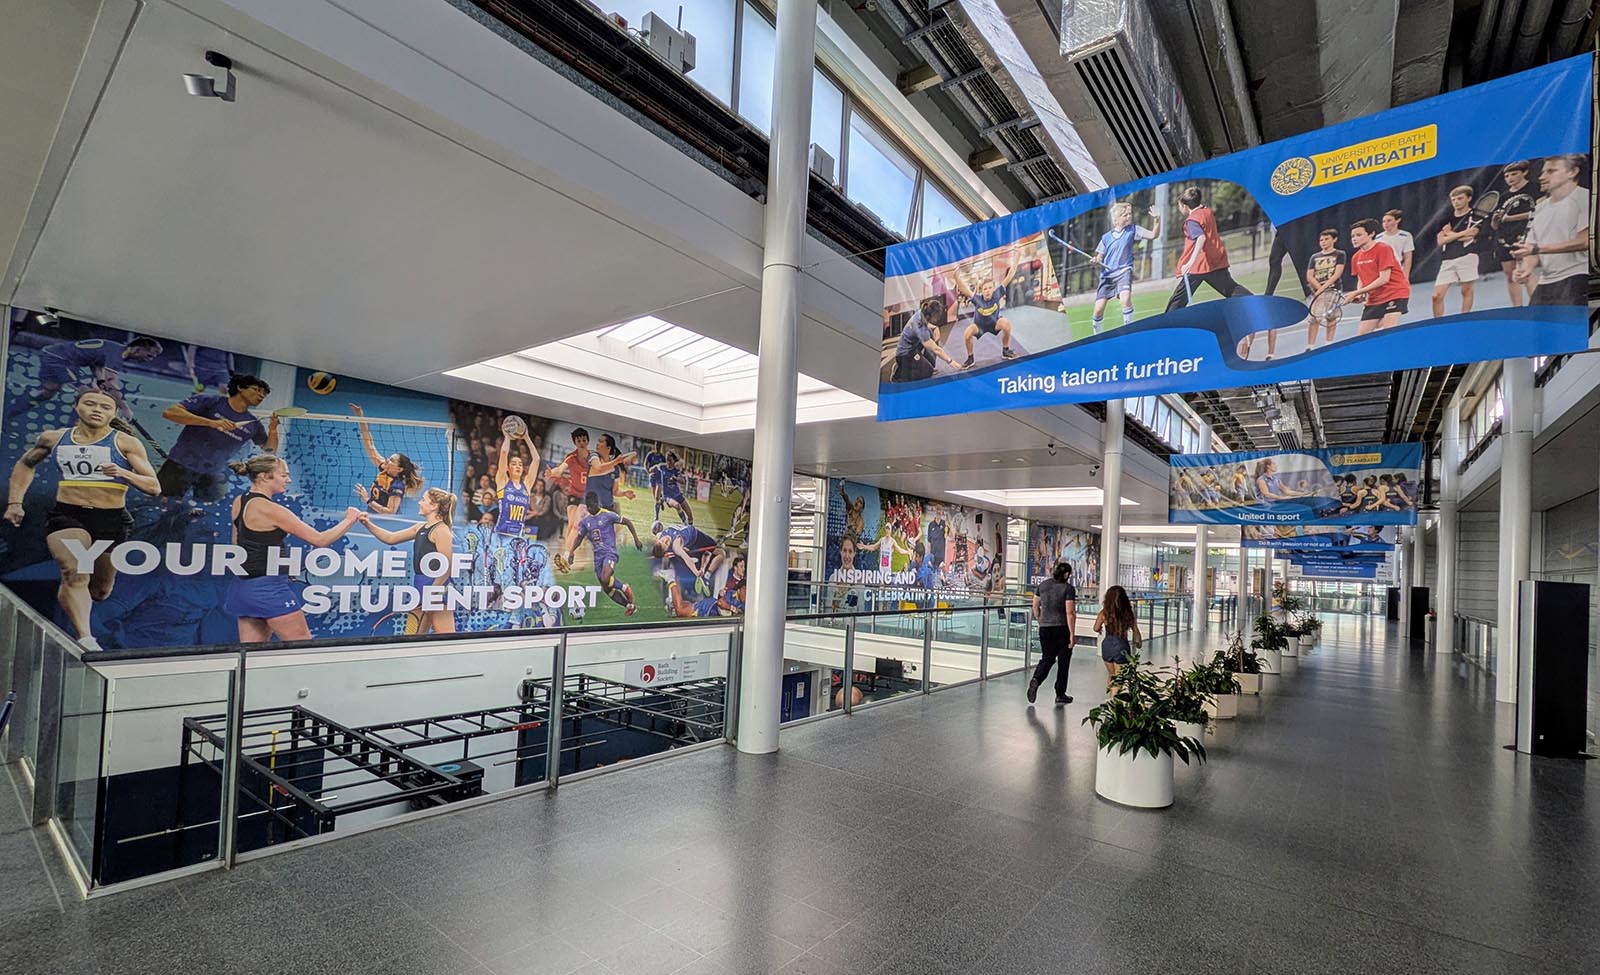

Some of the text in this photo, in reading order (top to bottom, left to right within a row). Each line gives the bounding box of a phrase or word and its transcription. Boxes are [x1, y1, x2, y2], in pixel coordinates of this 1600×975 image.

[1321, 132, 1426, 166] UNIVERSITY OF BATH
[1321, 143, 1426, 179] TEAMBATH
[998, 355, 1203, 394] Taking talent further
[510, 504, 525, 521] WA
[1276, 513, 1300, 521] sport
[62, 539, 473, 578] YOUR HOME OF
[834, 569, 916, 585] INSPIRING AND
[301, 584, 602, 613] STUDENT SPORT
